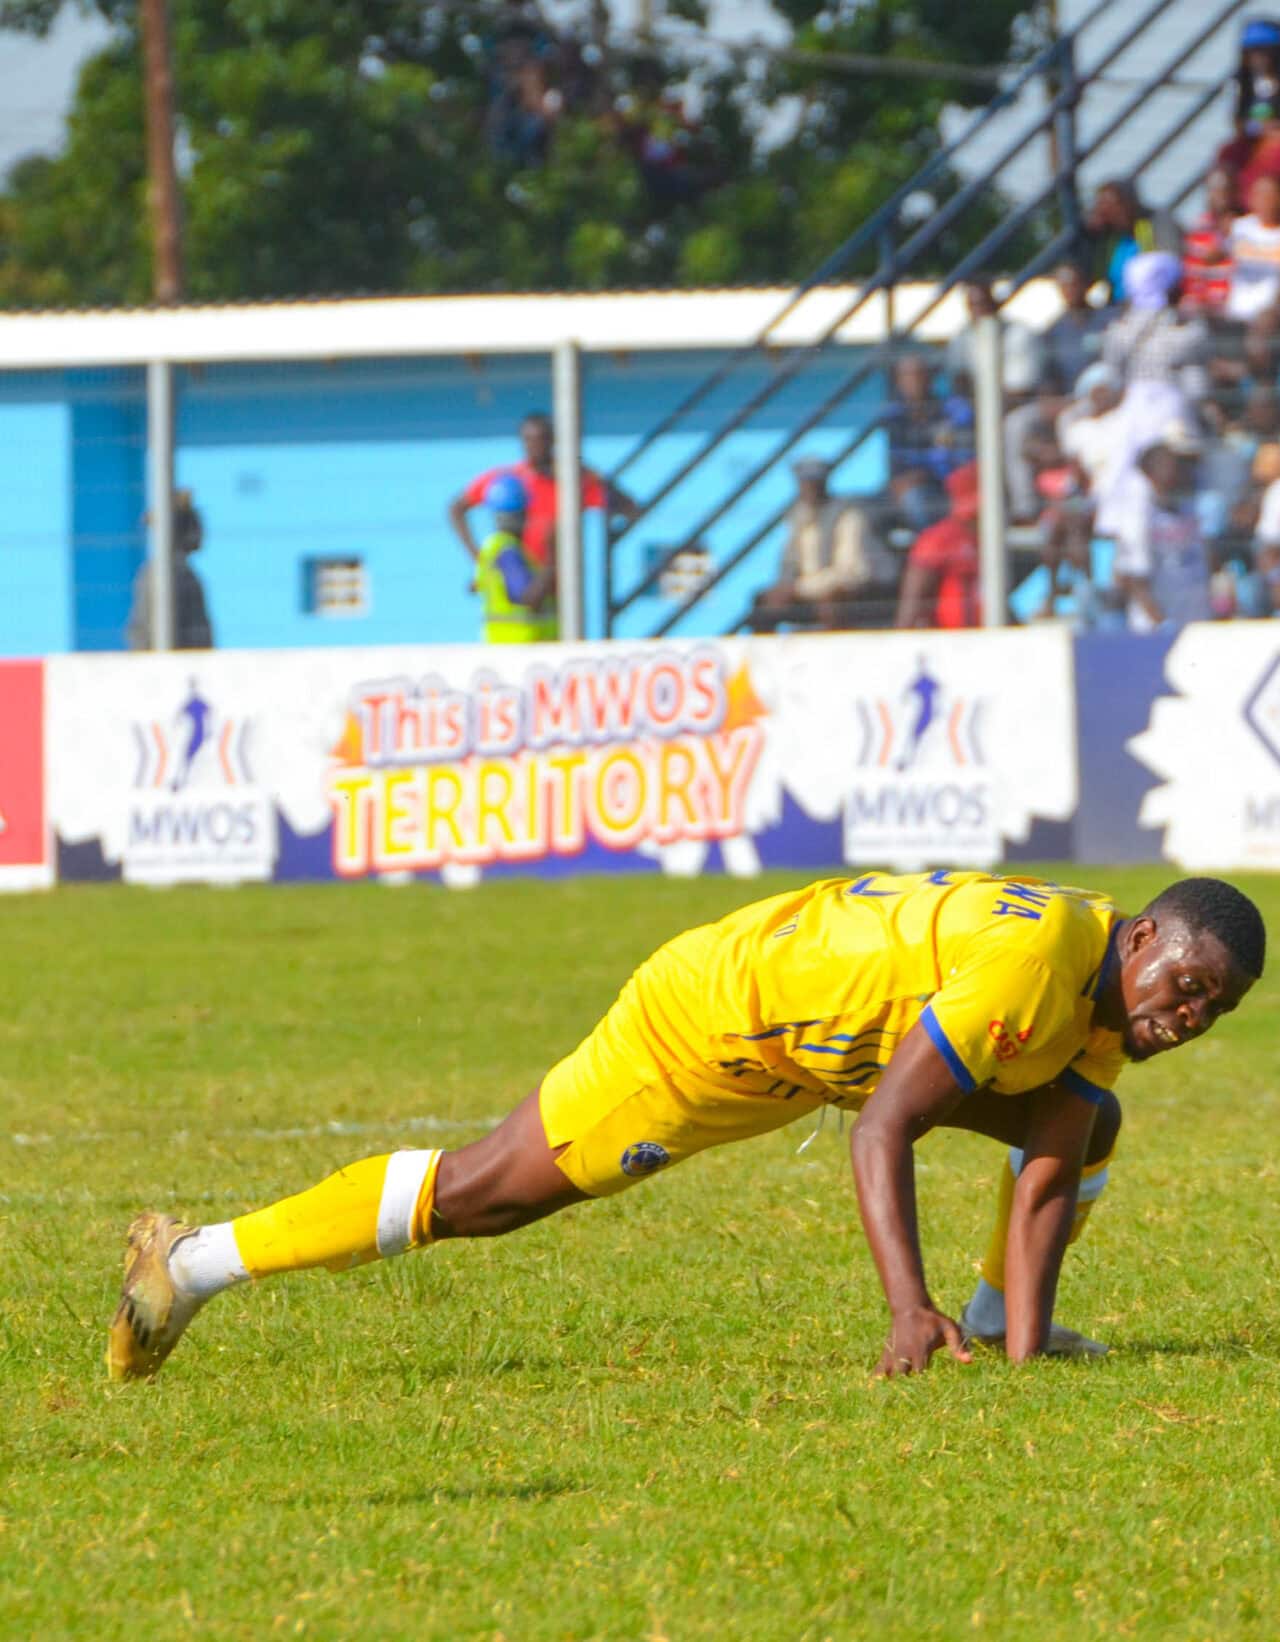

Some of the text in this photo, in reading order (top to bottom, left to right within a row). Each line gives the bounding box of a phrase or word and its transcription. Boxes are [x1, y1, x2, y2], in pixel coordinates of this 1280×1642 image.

[360, 658, 717, 752] This is MWOS
[130, 802, 257, 846] MWOS
[333, 735, 752, 859] TERRITORY
[848, 784, 988, 826] MWOS
